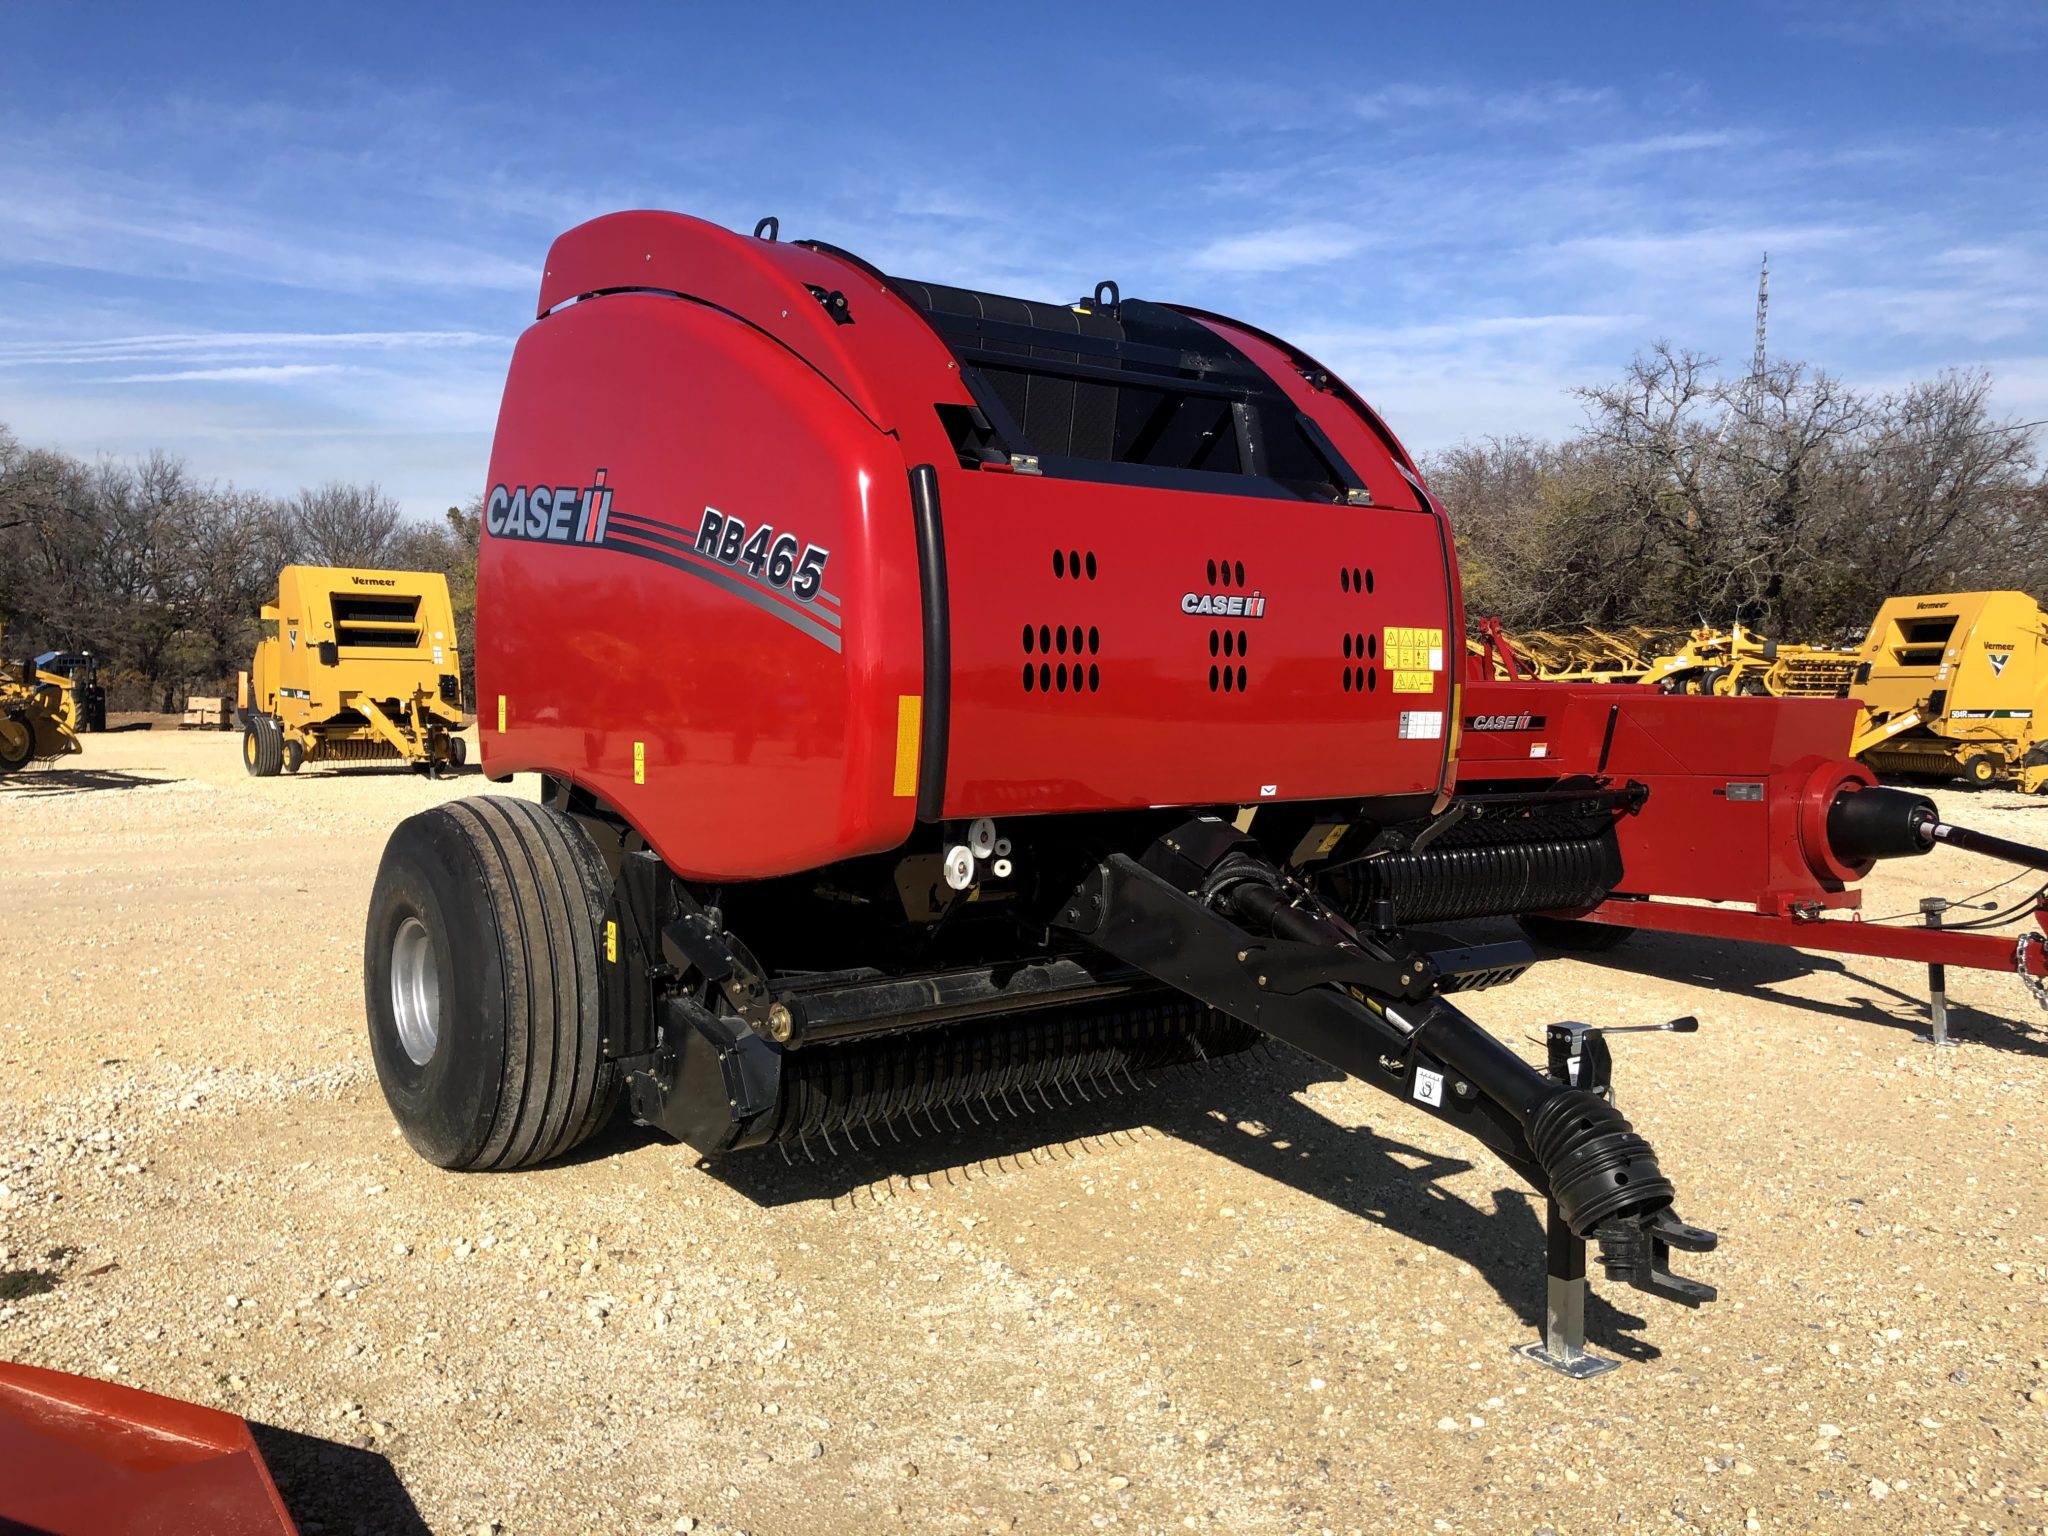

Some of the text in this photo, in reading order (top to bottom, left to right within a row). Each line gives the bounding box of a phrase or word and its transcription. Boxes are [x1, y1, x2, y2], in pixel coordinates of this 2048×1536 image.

[486, 484, 578, 541] CASE
[694, 505, 831, 602] RB465
[352, 576, 395, 586] Vermeer
[1181, 593, 1244, 615] CASE
[1916, 601, 1949, 610] Vermeer
[1983, 641, 2015, 651] Vermeer
[1473, 715, 1516, 730] CASE
